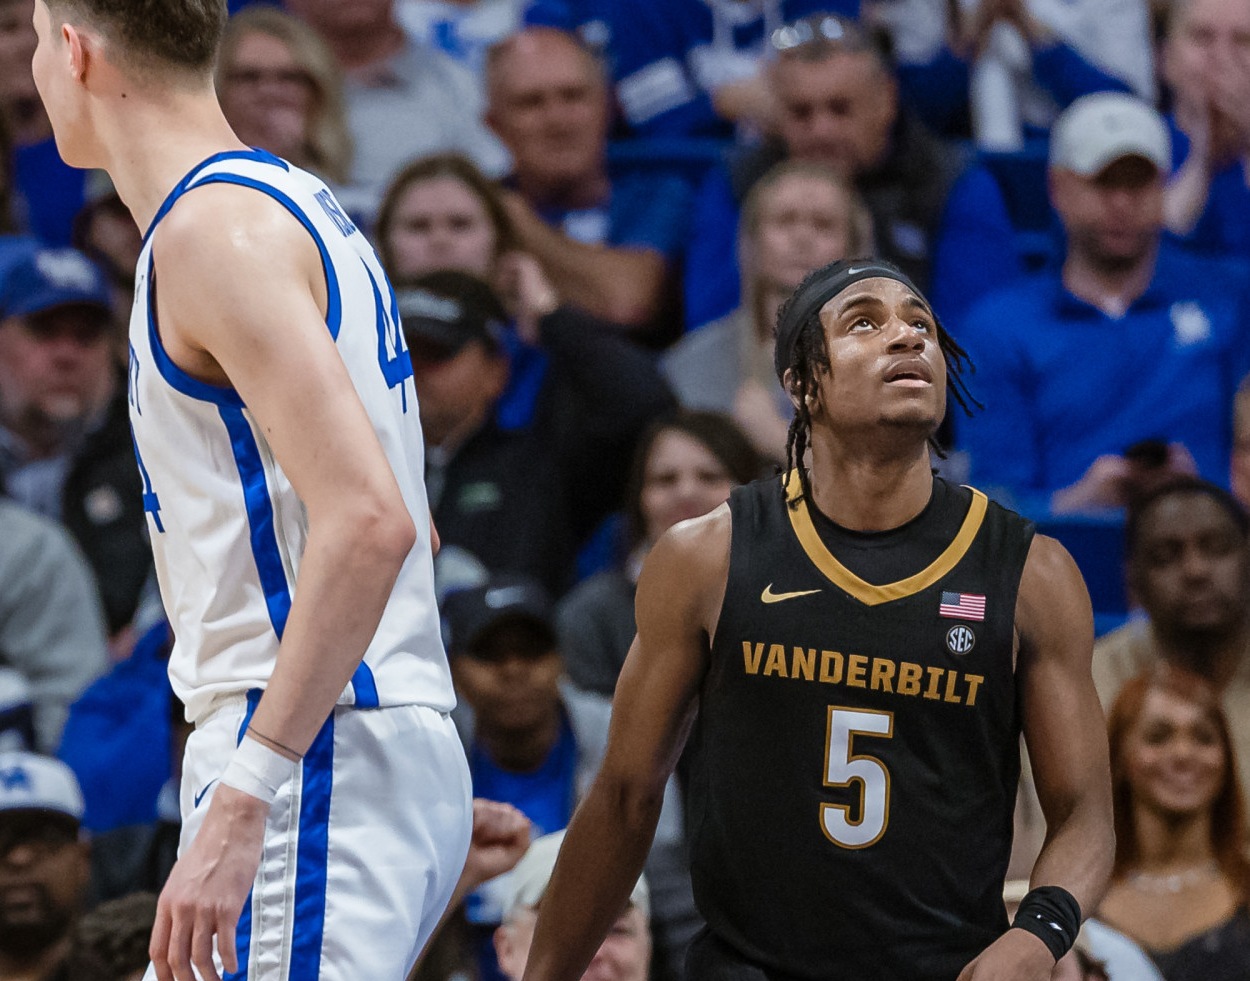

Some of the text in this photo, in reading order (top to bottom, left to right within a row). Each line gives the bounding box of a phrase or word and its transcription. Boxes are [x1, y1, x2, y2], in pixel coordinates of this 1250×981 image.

[947, 626, 974, 654] SEC
[742, 641, 985, 706] VANDERBILT
[819, 705, 894, 849] 5
